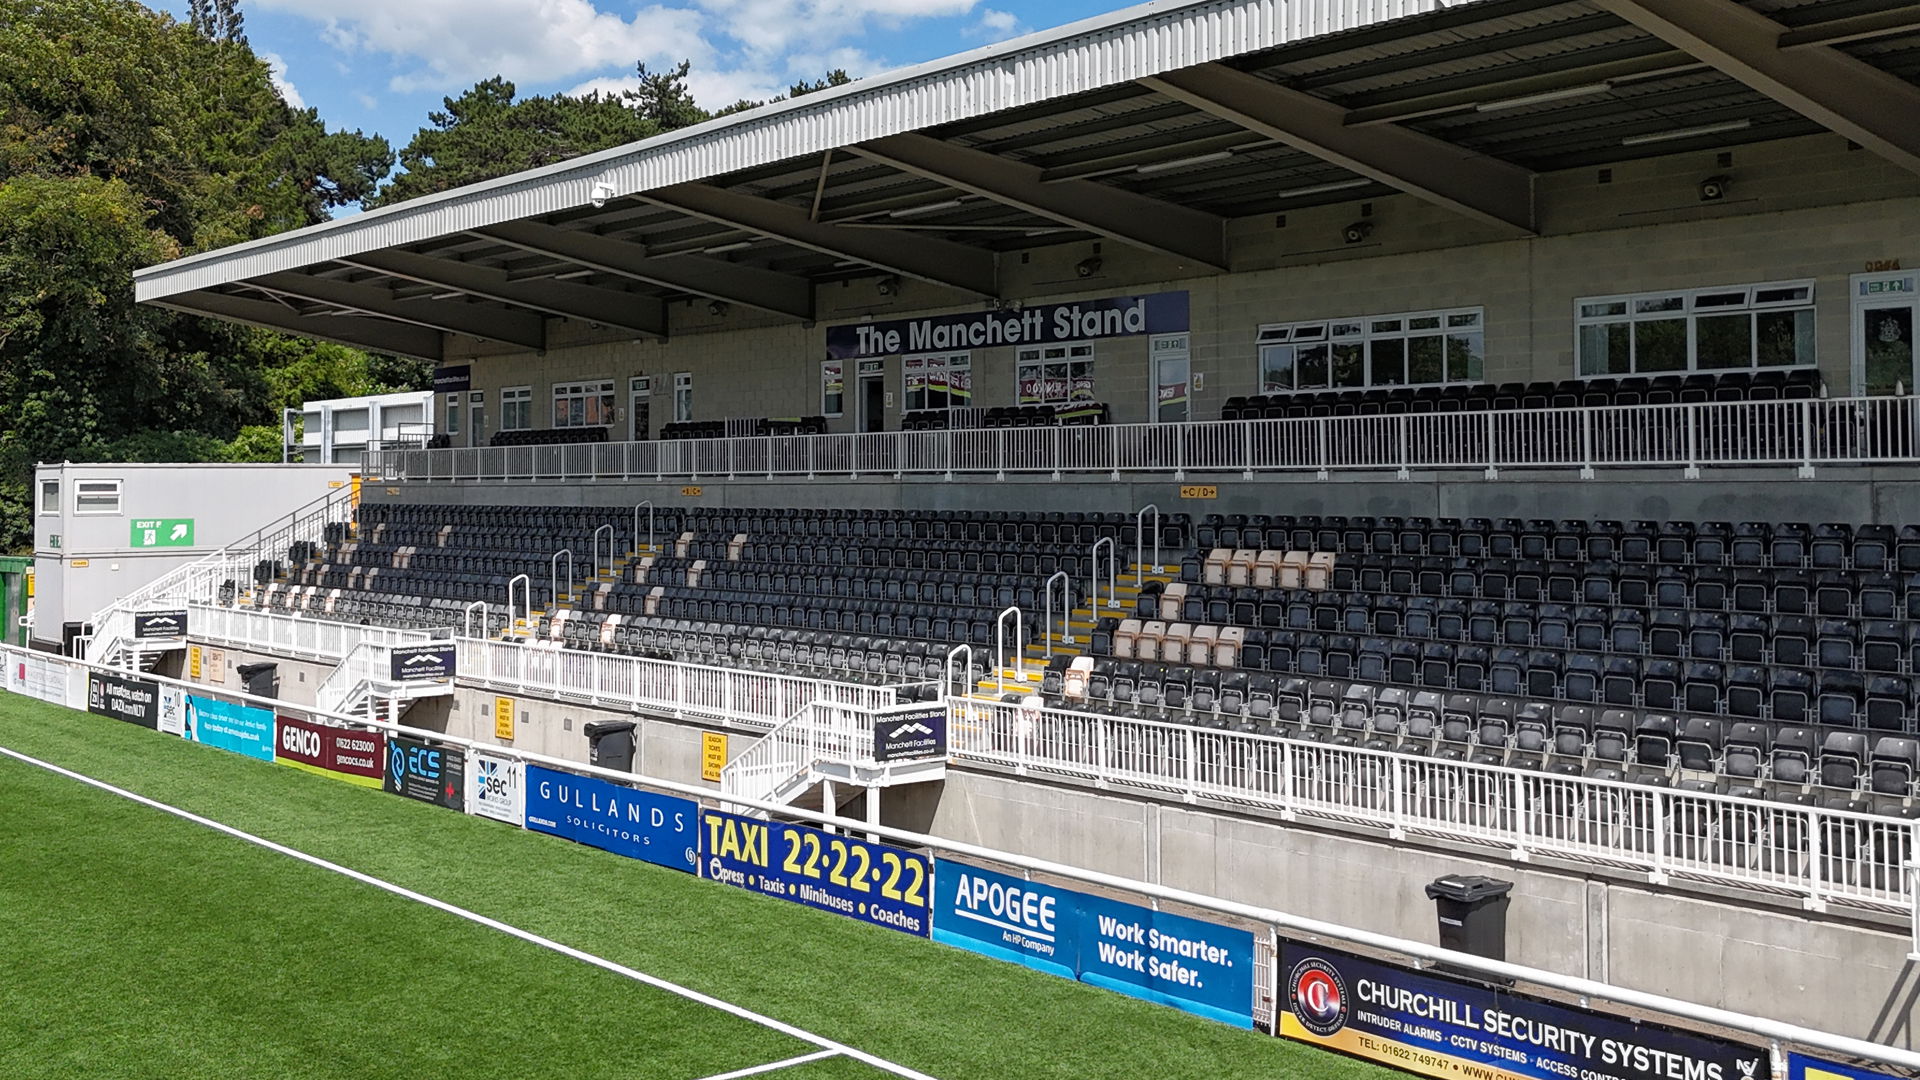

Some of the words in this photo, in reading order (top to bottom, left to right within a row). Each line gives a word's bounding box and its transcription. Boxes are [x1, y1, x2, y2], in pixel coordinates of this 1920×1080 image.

[856, 325, 900, 355] The
[909, 308, 1043, 350] Manchett
[1053, 299, 1146, 339] Stand
[136, 520, 155, 529] EXIT
[144, 692, 152, 703] on
[876, 714, 904, 723] Manchett
[905, 712, 929, 720] Facilities
[929, 710, 946, 718] Stand
[282, 725, 321, 758] GENCO
[336, 737, 351, 750] 01622
[351, 740, 375, 753] 623000
[885, 740, 913, 750] Manchett
[913, 738, 936, 747] Facilities
[336, 754, 374, 768] gencocs.co.uk
[408, 746, 440, 778] ECS
[486, 776, 507, 797] sec
[507, 766, 517, 789] 11
[540, 781, 684, 832] GULLANDS
[566, 815, 650, 845] SOLICITORS
[705, 815, 768, 867] TAXI
[758, 875, 785, 895] Taxis
[800, 884, 854, 913] Minibuses
[870, 904, 920, 931] Coaches
[955, 873, 1056, 932] APOGEE
[1003, 930, 1012, 942] An
[1013, 932, 1022, 945] HP
[1021, 936, 1055, 956] Company
[1099, 915, 1144, 945] Work
[1149, 928, 1233, 967] Smarter.
[1099, 942, 1144, 973] Work
[1149, 955, 1203, 988] Safer.
[1357, 979, 1480, 1029] CHURCHILL
[1484, 1010, 1598, 1059] SECURITY
[1601, 1039, 1723, 1080] SYSTEMS
[1357, 1010, 1401, 1032] INTRUDER
[1403, 1022, 1442, 1042] ALARMS
[1451, 1034, 1478, 1051] CCTV
[1479, 1041, 1527, 1064] SYSTEMS
[1535, 1056, 1578, 1077] ACCESS
[1358, 1036, 1380, 1052] TEL:
[1382, 1043, 1411, 1061] 01622
[1413, 1052, 1449, 1071] 749747
